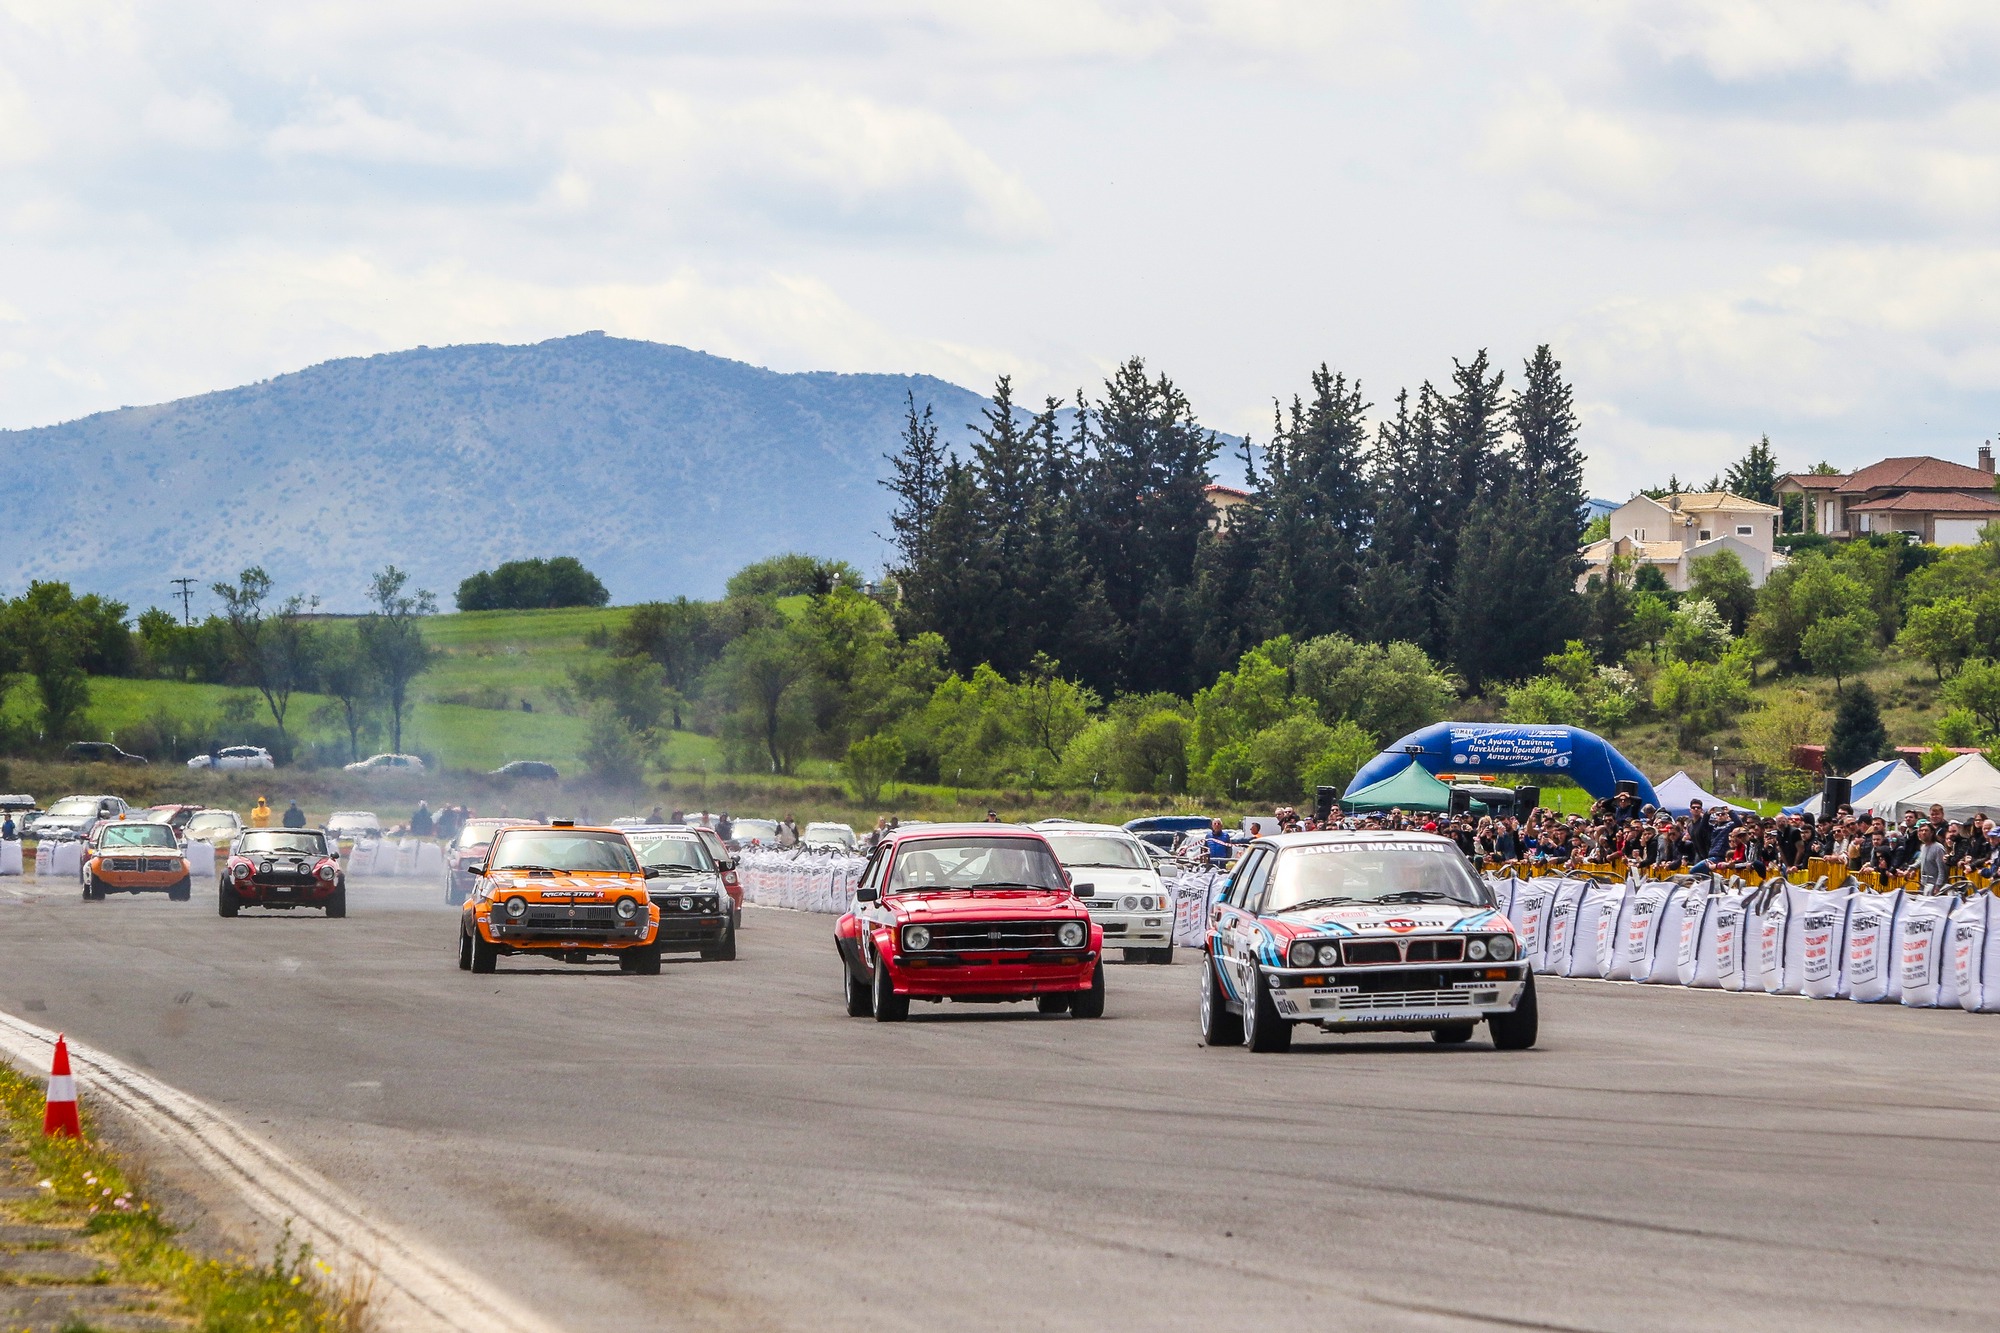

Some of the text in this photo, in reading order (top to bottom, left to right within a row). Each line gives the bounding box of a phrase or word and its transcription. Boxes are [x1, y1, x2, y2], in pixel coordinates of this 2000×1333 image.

[1517, 738, 1555, 747] Ταχύτητας
[1468, 745, 1558, 755] Πανελλήνιο Πρωτάθλημα
[1487, 753, 1534, 761] Αυτοκινήτων
[1294, 843, 1445, 855] LANCIA MARTINI
[1357, 921, 1444, 929] MARTINI
